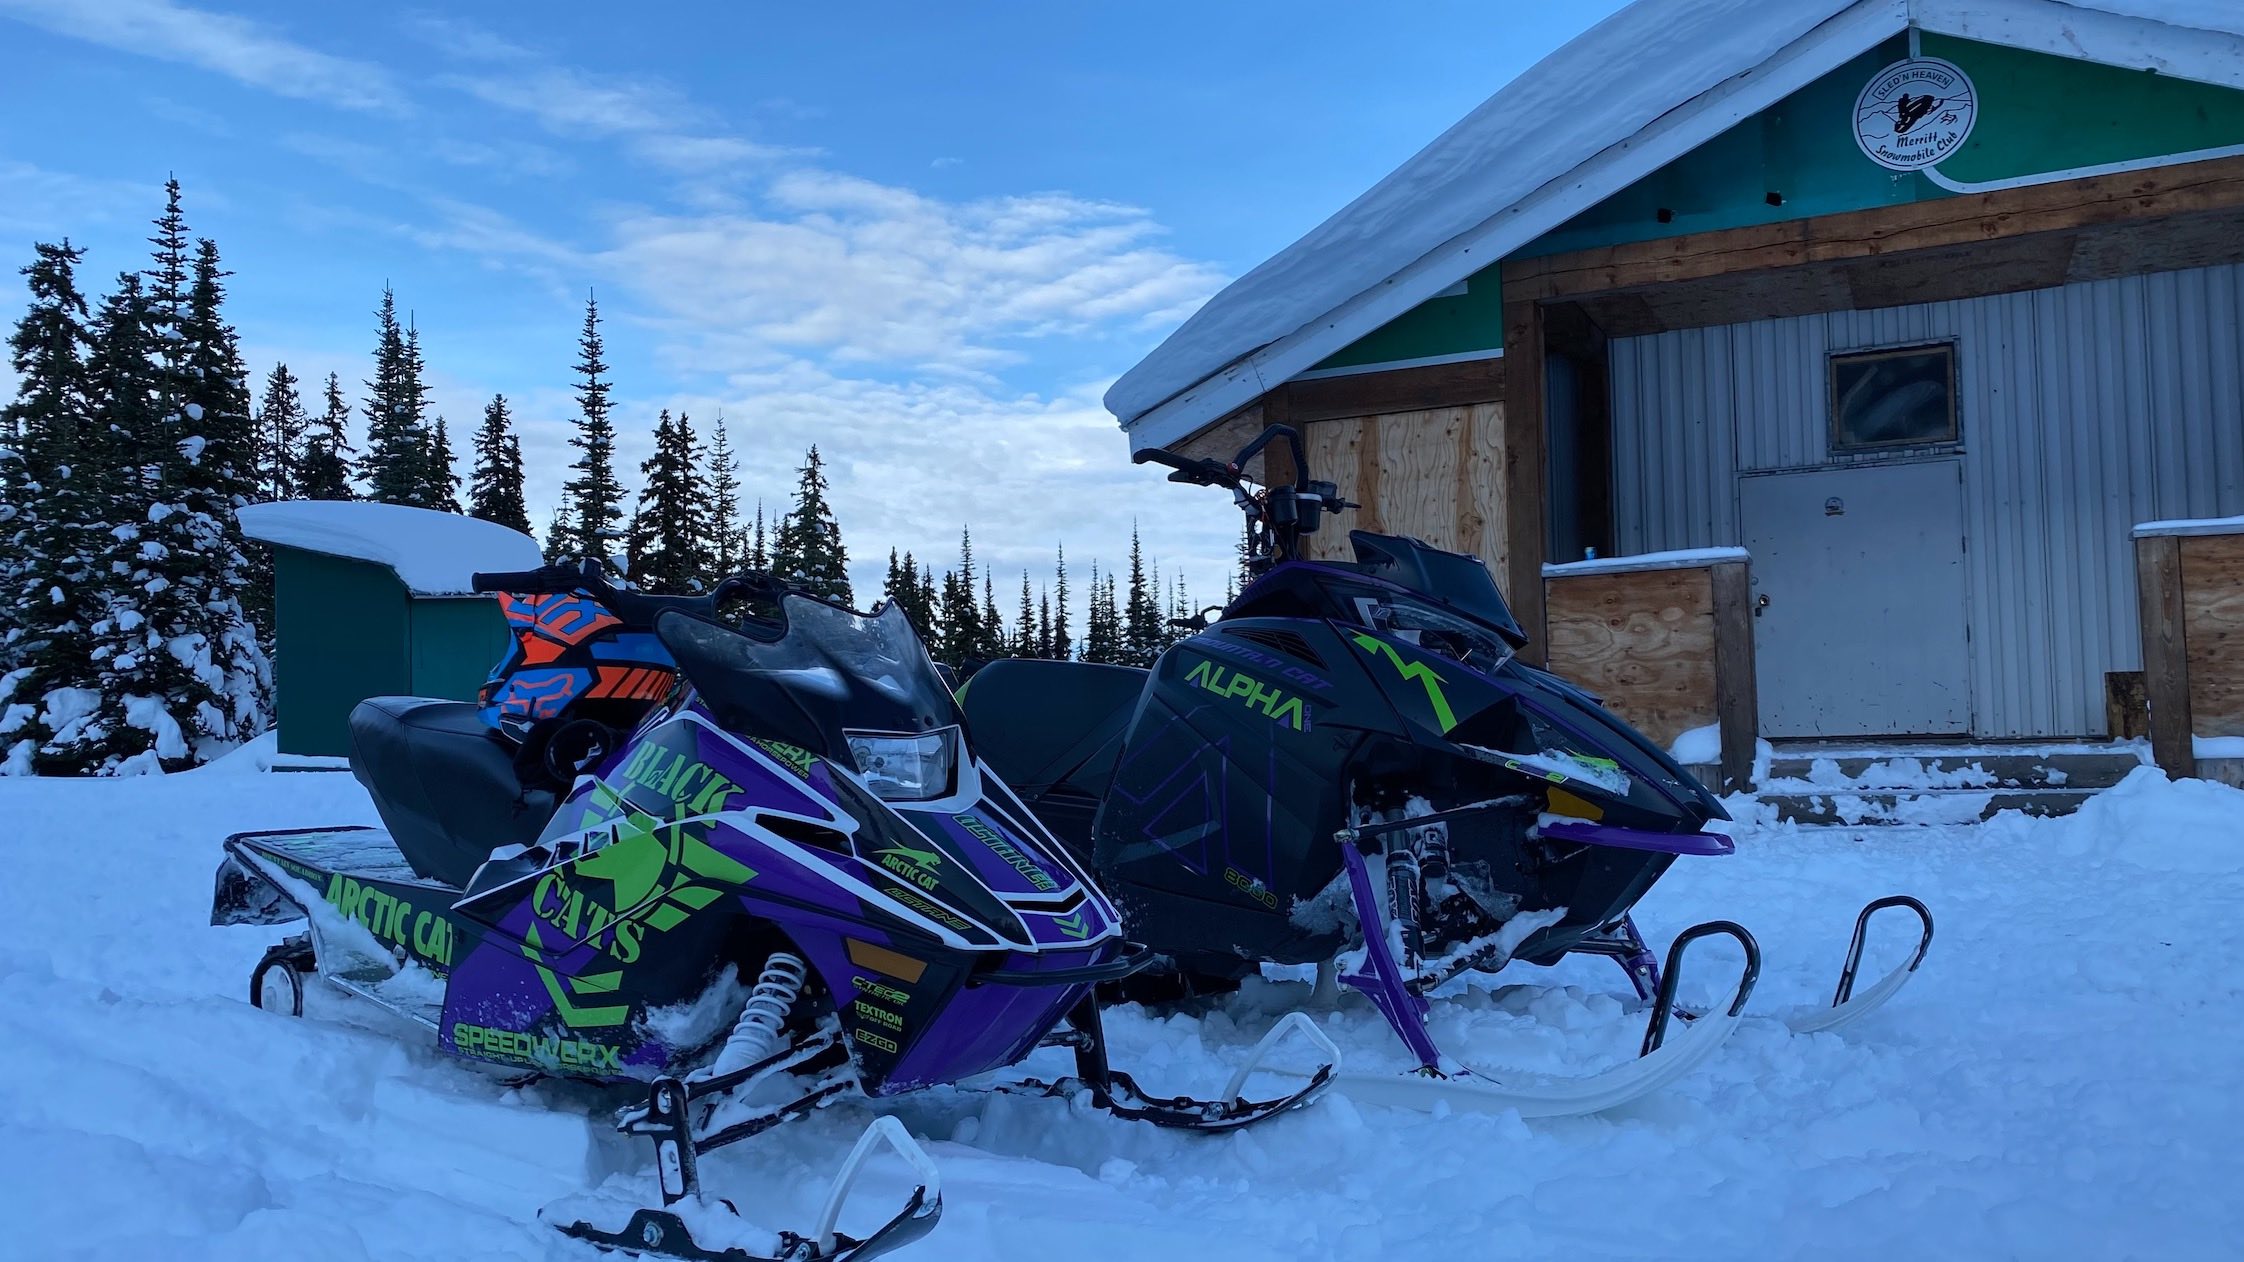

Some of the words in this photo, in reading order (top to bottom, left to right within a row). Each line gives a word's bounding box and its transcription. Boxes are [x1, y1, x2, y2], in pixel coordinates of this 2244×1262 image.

[1878, 72, 1910, 97] SLED'N
[1912, 70, 1951, 86] HEAVEN
[1876, 144, 1935, 162] Snowmobile
[1937, 131, 1958, 151] Club
[1897, 131, 1937, 148] Merritt
[1184, 660, 1303, 732] ALPHA
[1304, 704, 1312, 733] ONE
[755, 740, 810, 780] HORSEPOWER
[622, 740, 746, 830] BLACK
[881, 853, 919, 881] ARCTIC
[918, 873, 939, 891] CAT
[326, 872, 412, 945] ARCTIC
[533, 873, 645, 963] CATS
[854, 999, 903, 1026] TEXTRON
[454, 1022, 622, 1069] SPEEDWERX
